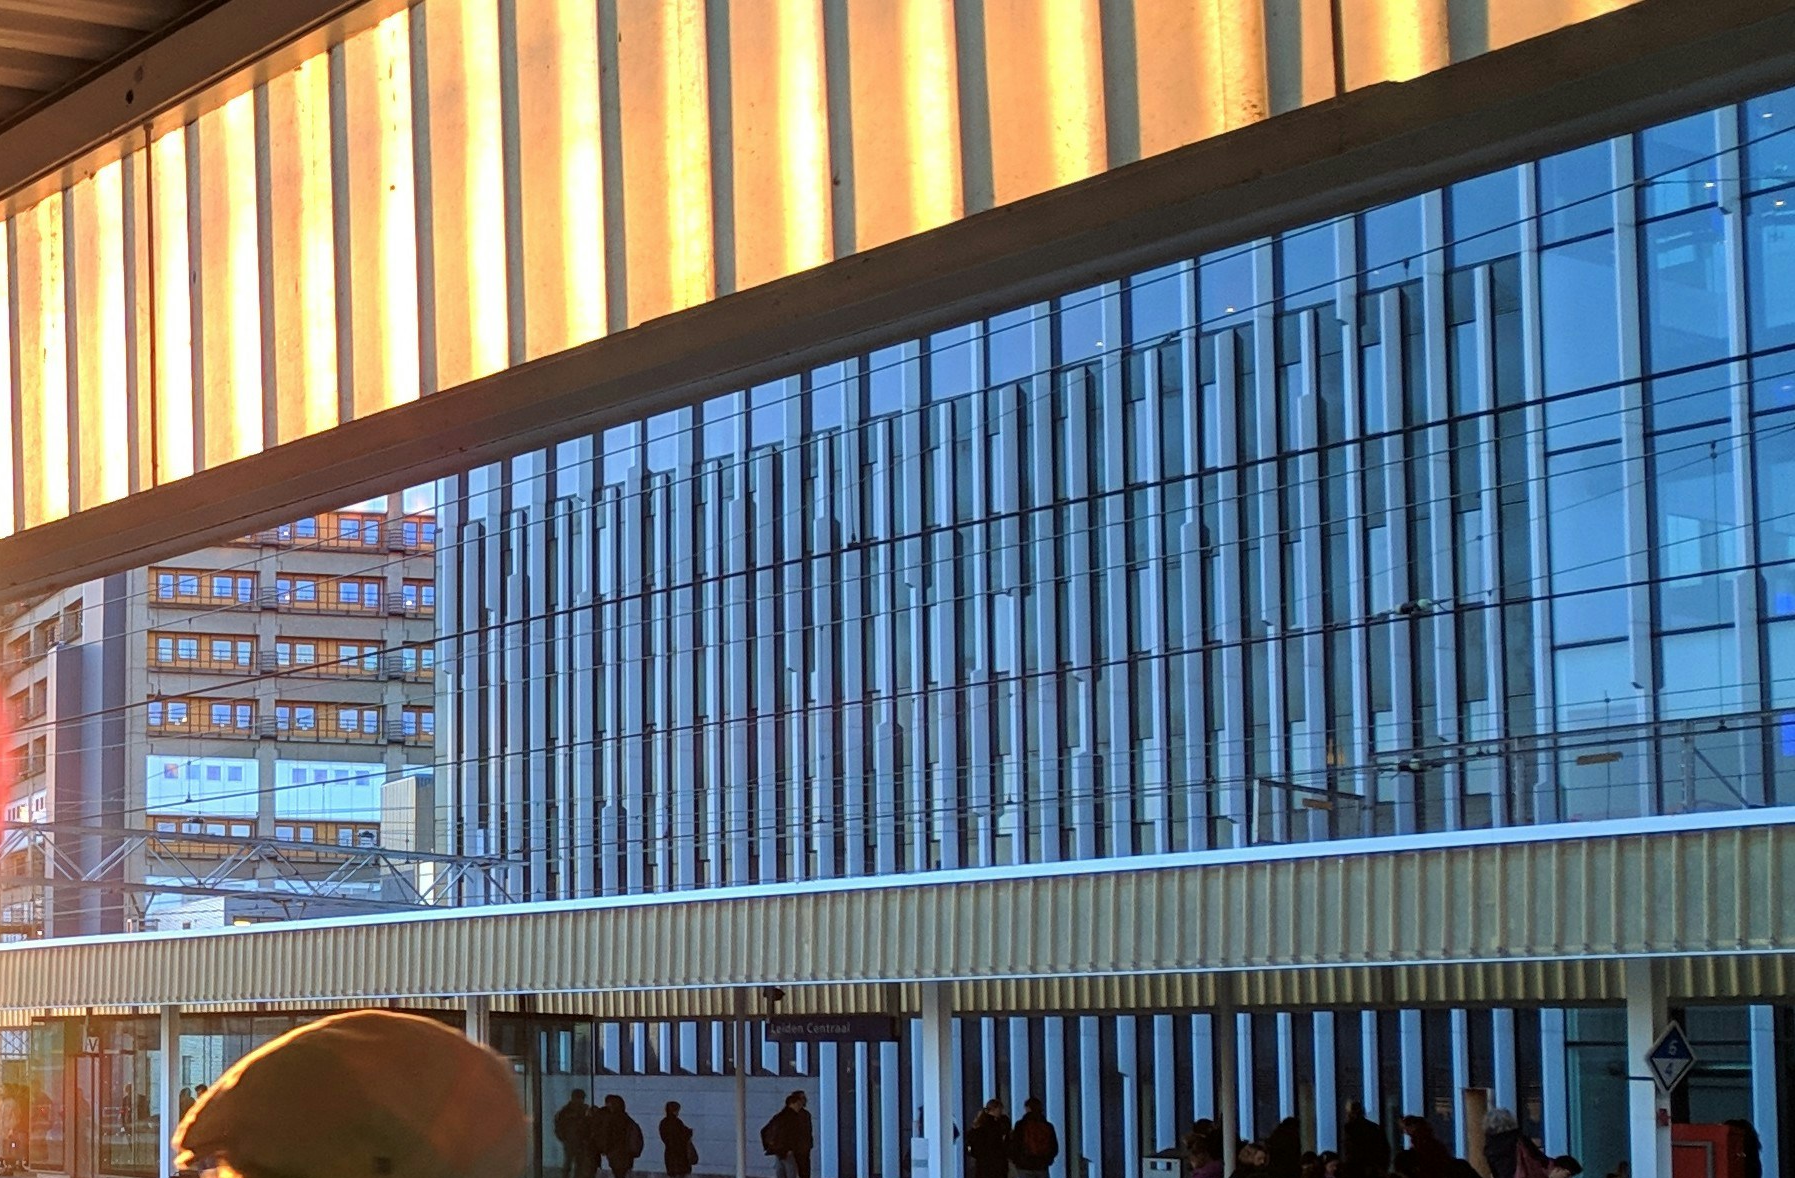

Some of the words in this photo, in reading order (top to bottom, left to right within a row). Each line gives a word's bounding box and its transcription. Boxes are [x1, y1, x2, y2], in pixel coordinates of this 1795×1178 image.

[771, 1022, 804, 1034] Leiden
[806, 1022, 851, 1034] Centraal
[88, 1038, 98, 1052] V
